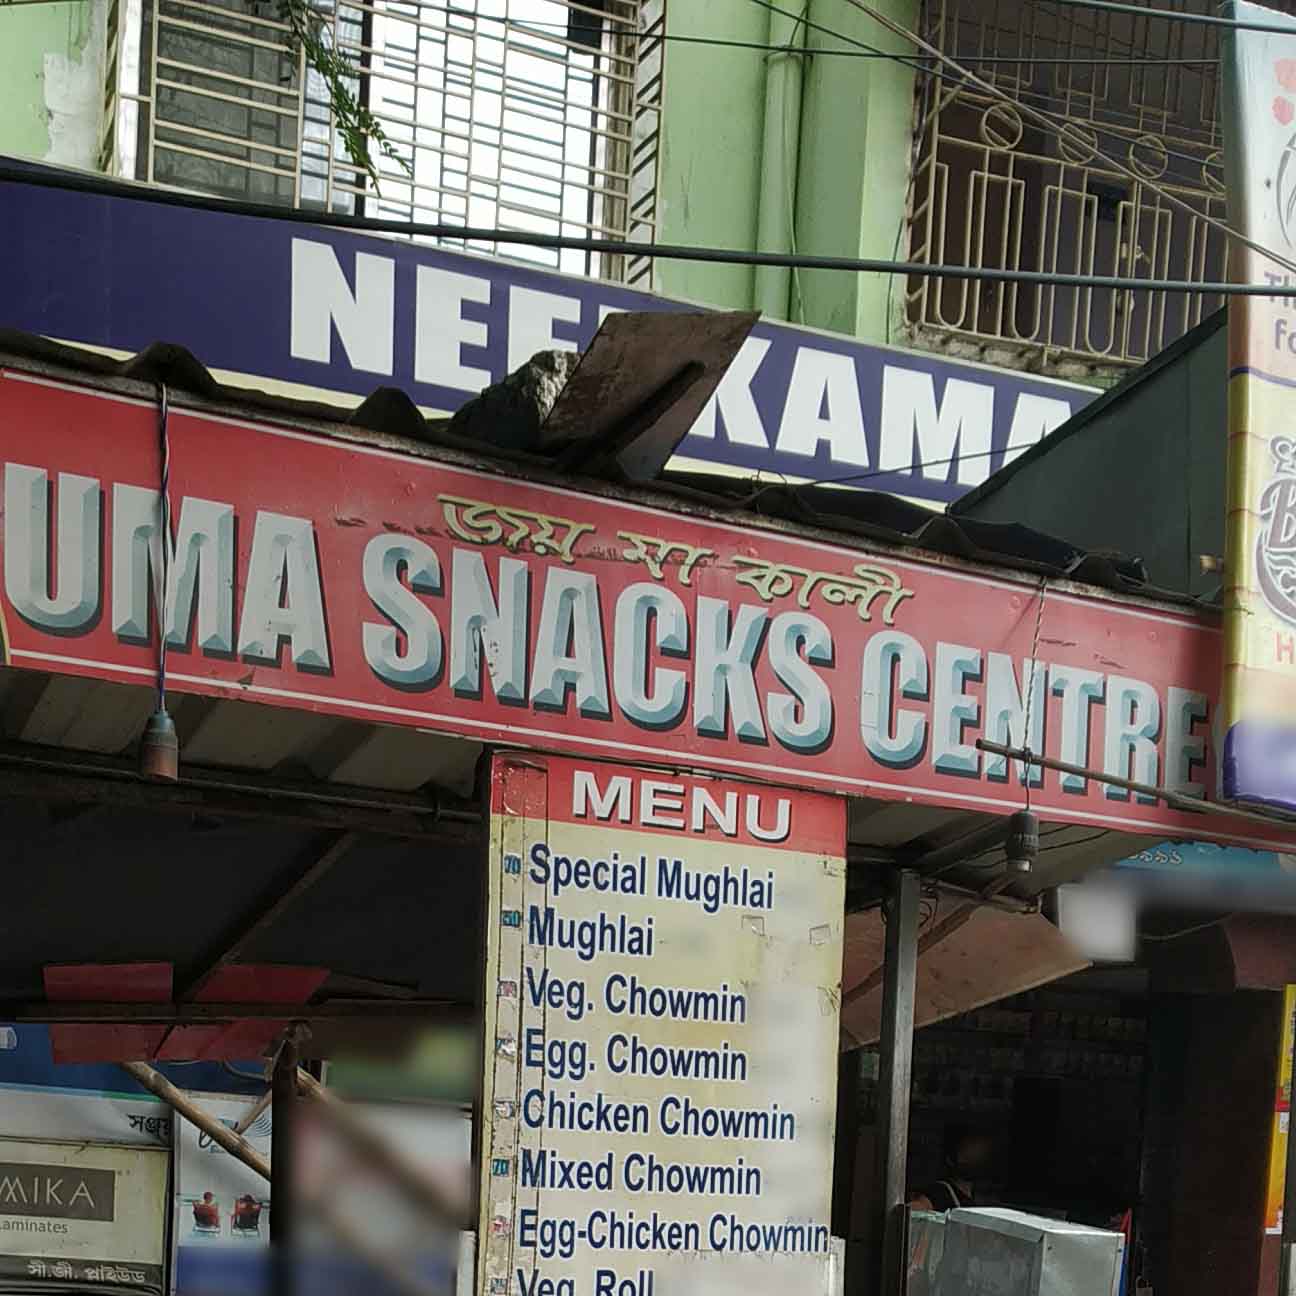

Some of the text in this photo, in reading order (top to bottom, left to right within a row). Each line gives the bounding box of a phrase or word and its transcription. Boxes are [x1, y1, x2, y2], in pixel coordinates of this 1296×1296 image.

[289, 237, 1074, 487] NEEKAMA
[437, 494, 914, 626] জয় মা কালী
[3, 461, 1211, 814] UMA SNACKS CENTRE
[571, 769, 792, 844] MENU
[529, 842, 774, 914] Special Mughlai
[528, 904, 655, 961] Mughlai
[525, 967, 747, 1023] Veg. Chowmin
[525, 1027, 748, 1082] Egg. Chowmin
[522, 1087, 796, 1140] Chicken Chowmin
[520, 1147, 761, 1196] Mixed Chowmin
[0, 1218, 69, 1235] aminates
[518, 1207, 829, 1259] Egg-Chicken Chowmin
